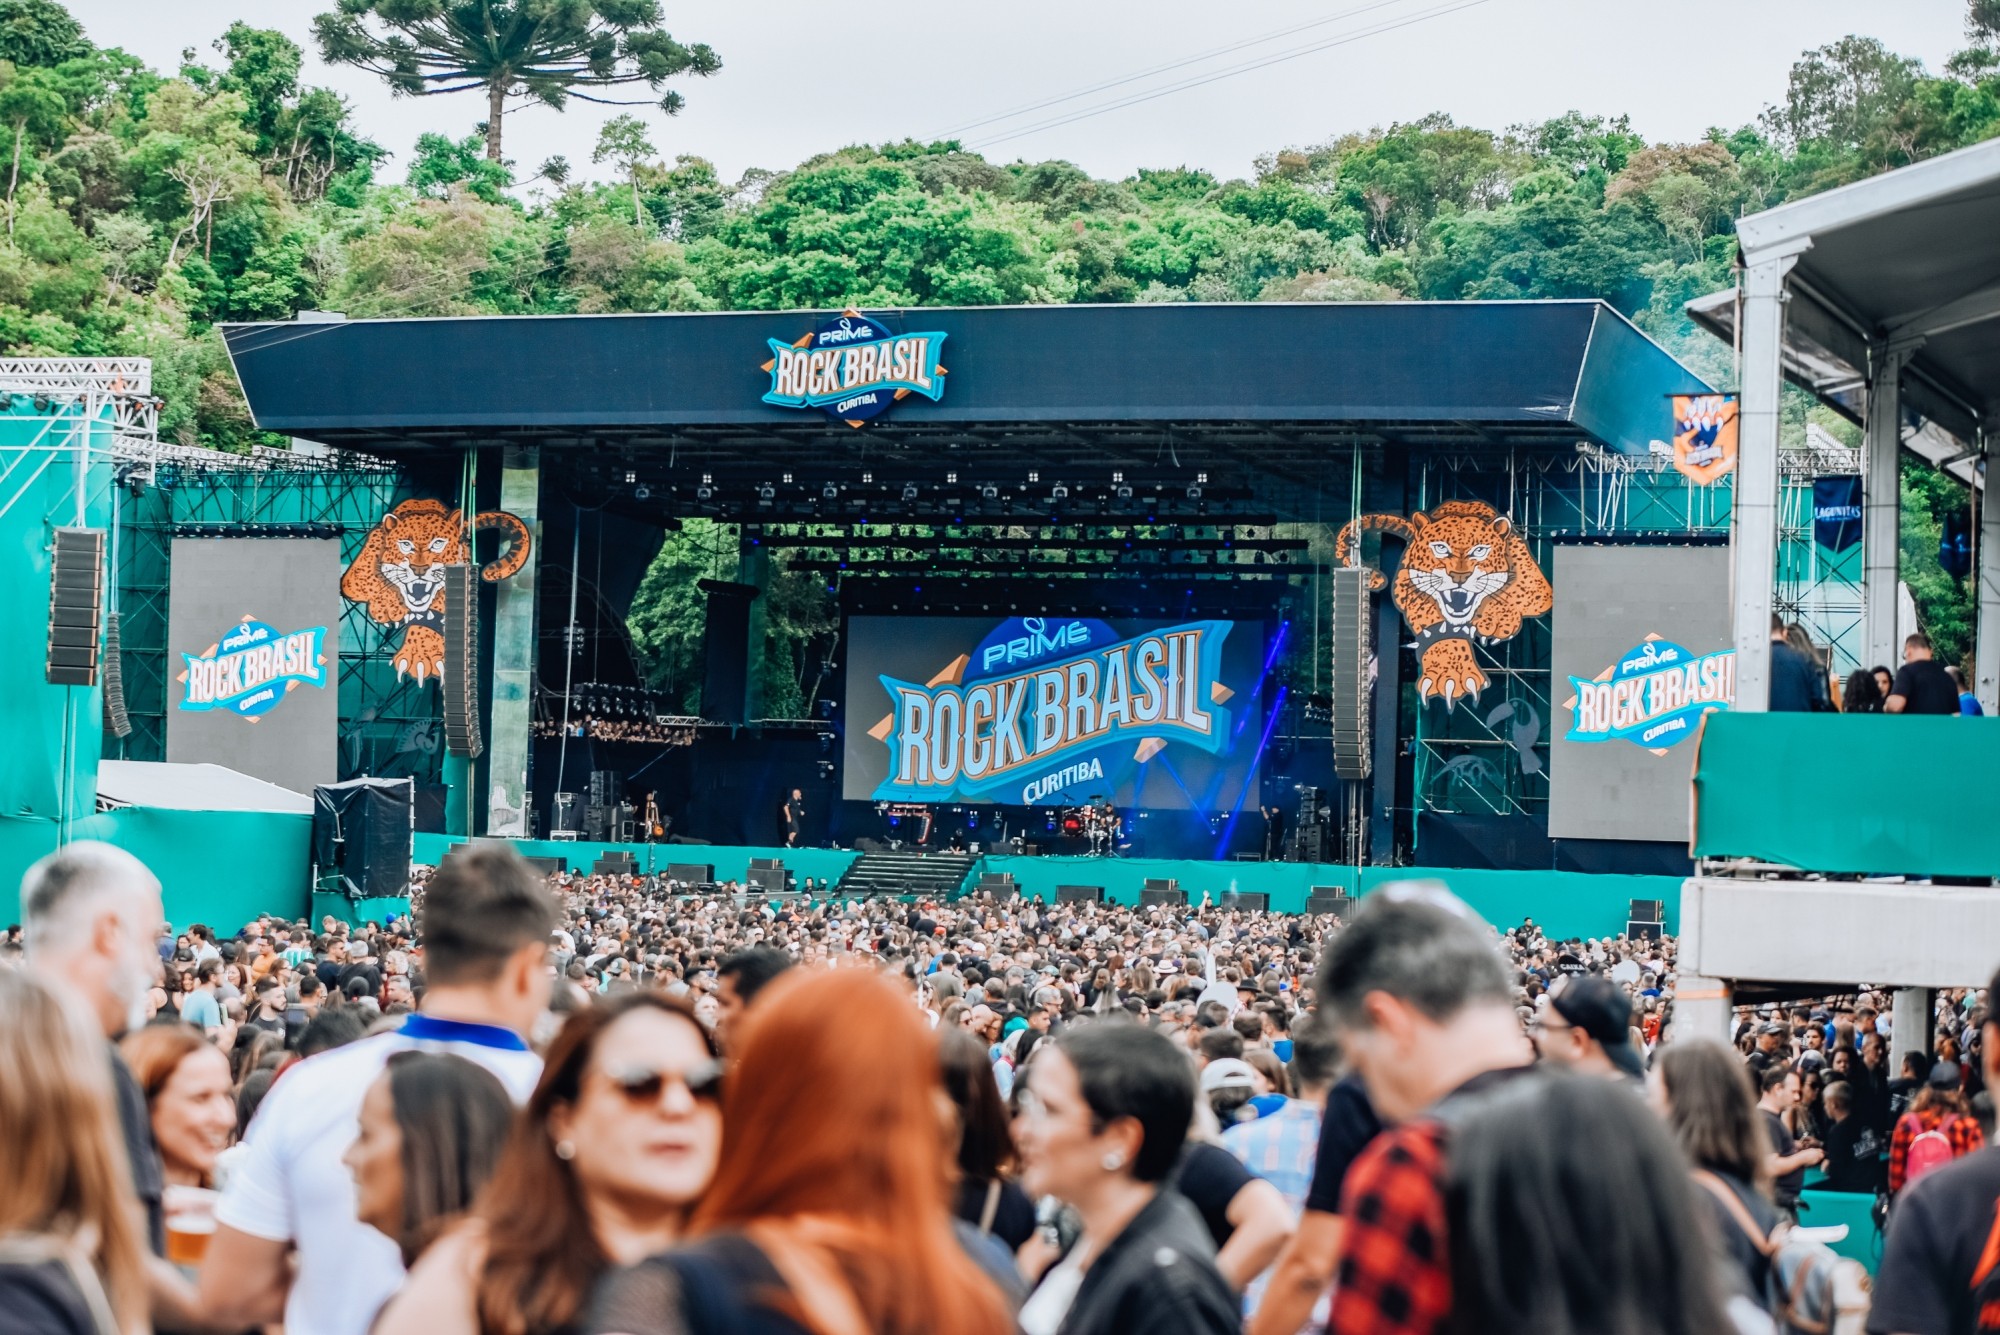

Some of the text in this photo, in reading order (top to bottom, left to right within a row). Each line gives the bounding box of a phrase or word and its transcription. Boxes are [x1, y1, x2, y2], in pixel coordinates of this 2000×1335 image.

[819, 325, 873, 345] PRIME
[777, 339, 931, 396] ROCK BRASIL
[837, 393, 877, 413] CURITIBA
[1814, 505, 1861, 519] LAGUNITAS
[223, 628, 268, 651] PRIME
[983, 621, 1089, 671] PRIME
[189, 633, 319, 701] ROCK BRASIL
[1622, 648, 1679, 674] PRIME
[239, 689, 274, 710] CURITIBA
[899, 631, 1211, 782] ROCK BRASIL
[1578, 678, 1646, 732] ROCK
[1643, 717, 1686, 742] CURITIBA
[1022, 758, 1103, 805] CURITIBA
